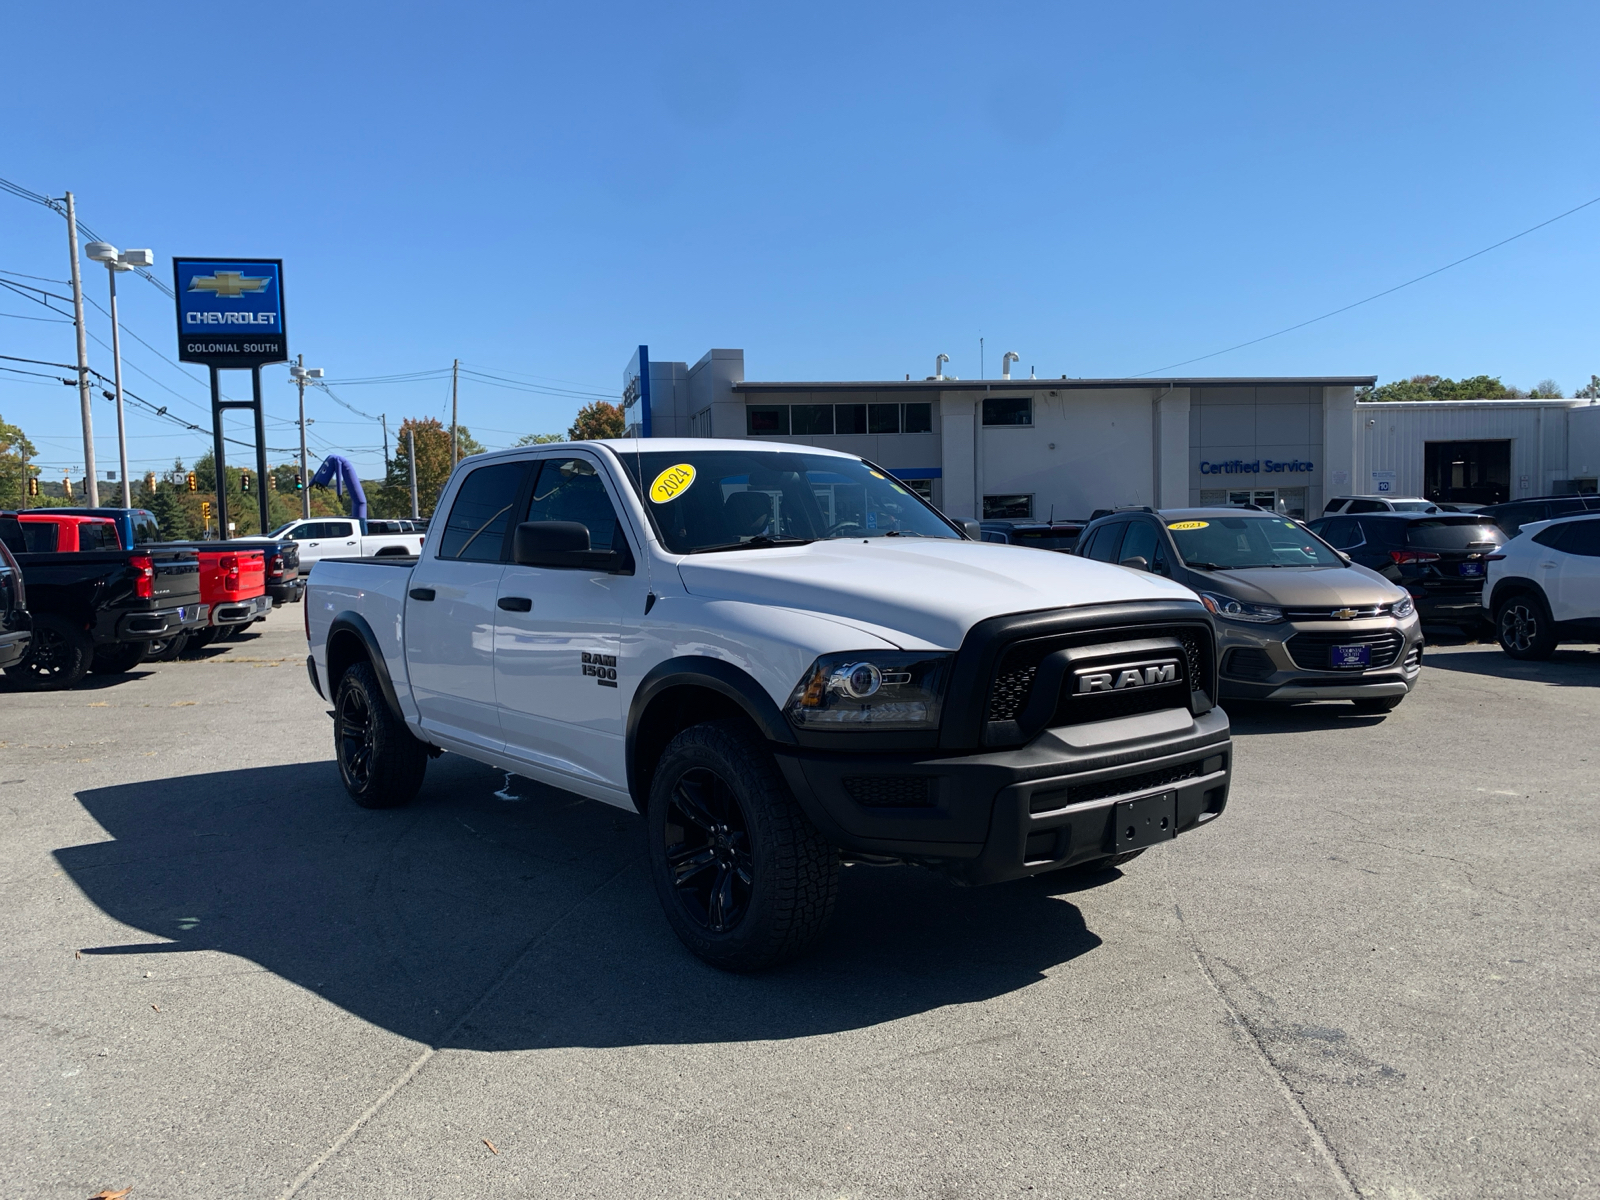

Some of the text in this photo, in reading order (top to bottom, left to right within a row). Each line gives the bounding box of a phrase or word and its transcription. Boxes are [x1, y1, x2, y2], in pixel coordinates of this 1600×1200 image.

[186, 311, 277, 325] CHEVROLET
[187, 343, 279, 353] COLONIAL SOUTH
[1200, 460, 1314, 475] Certified Service
[657, 467, 691, 498] 2024
[1175, 522, 1202, 530] 2021
[581, 651, 617, 668] RAM
[581, 664, 617, 680] 1500
[1079, 664, 1175, 693] RAM
